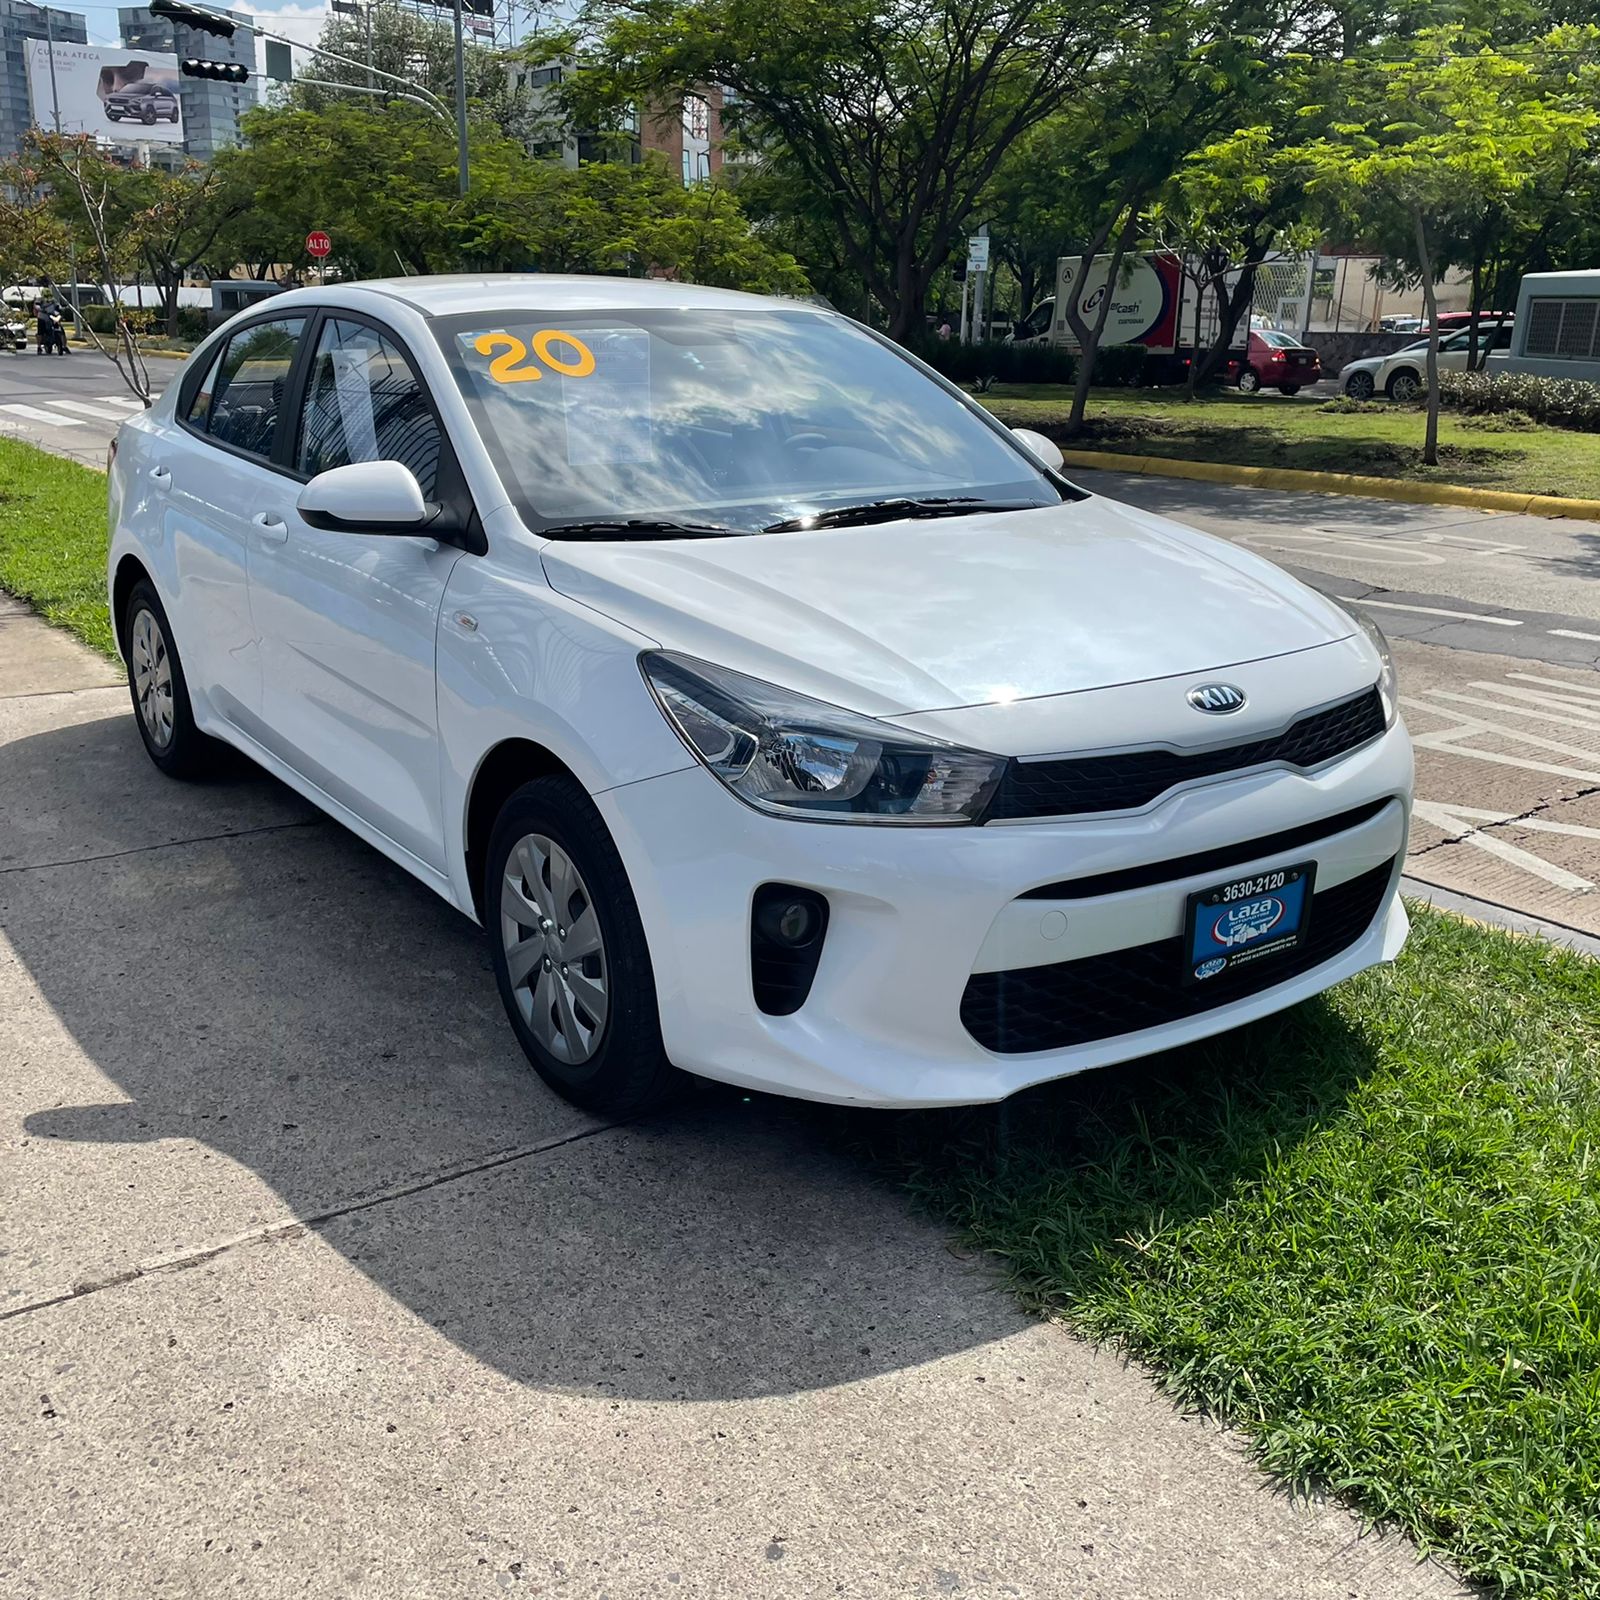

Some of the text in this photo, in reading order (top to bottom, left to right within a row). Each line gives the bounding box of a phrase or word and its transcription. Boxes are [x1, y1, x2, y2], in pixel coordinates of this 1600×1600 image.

[71, 52, 101, 60] ATECA
[308, 239, 330, 249] ALTO
[474, 330, 596, 383] 20
[1203, 686, 1242, 709] KIA
[1223, 872, 1285, 902] 3630-2120
[1228, 899, 1272, 922] Laza
